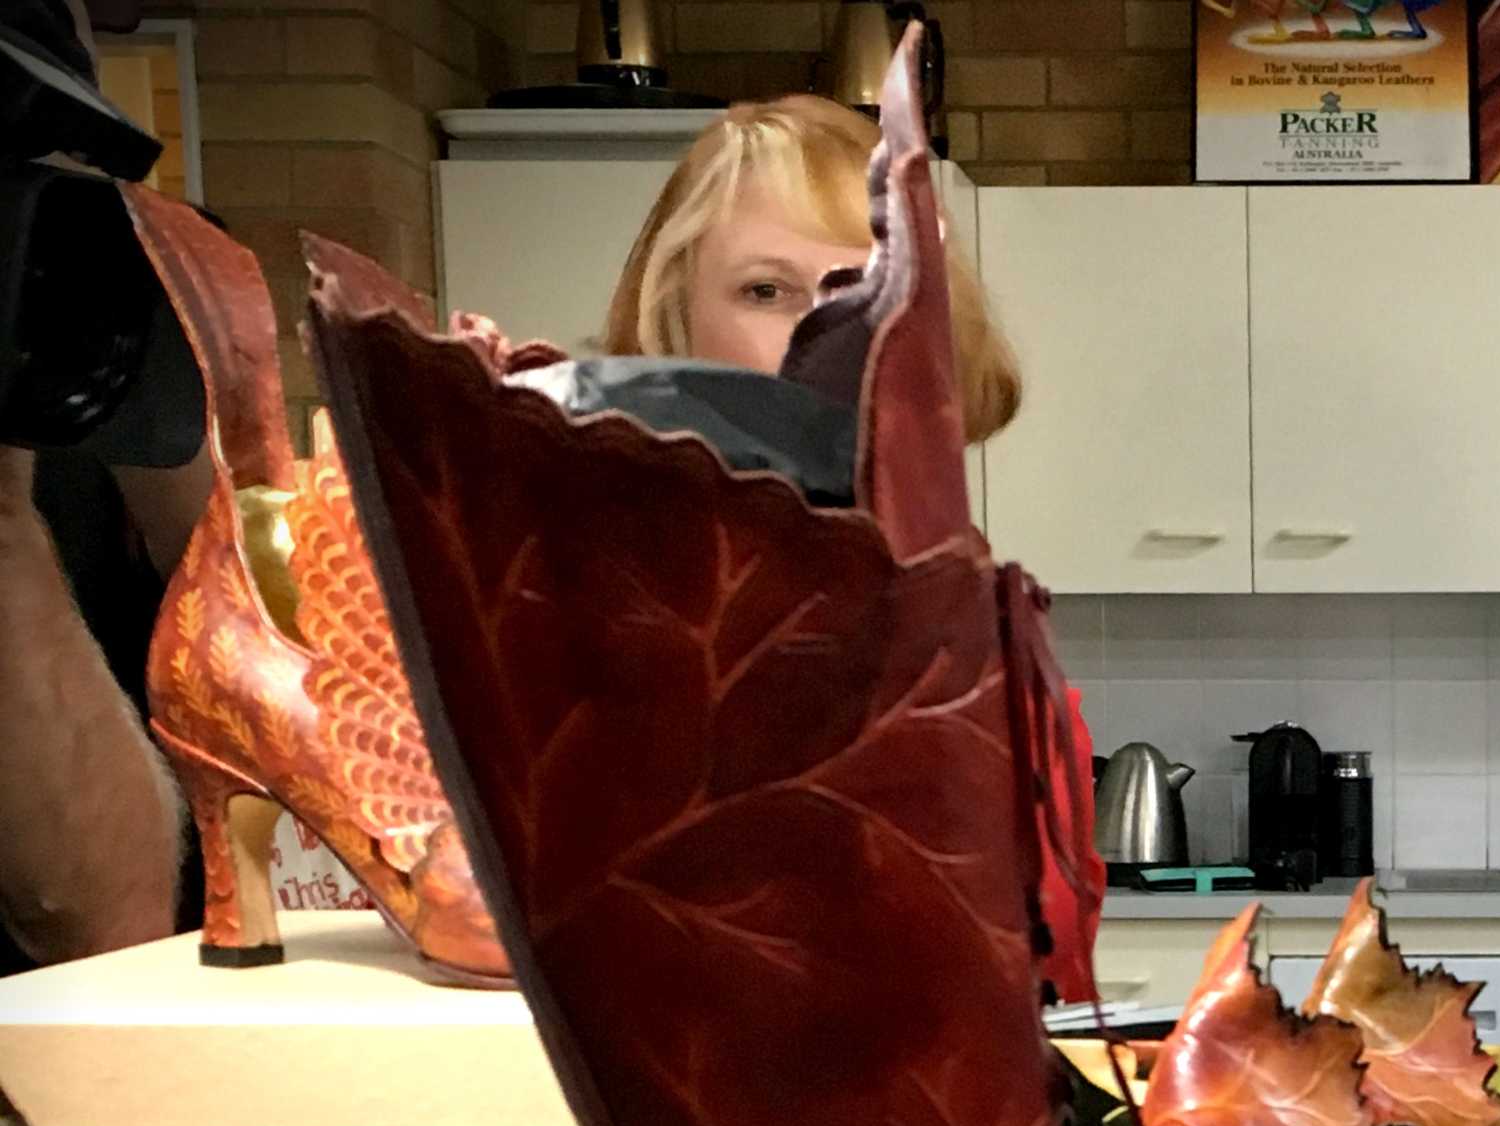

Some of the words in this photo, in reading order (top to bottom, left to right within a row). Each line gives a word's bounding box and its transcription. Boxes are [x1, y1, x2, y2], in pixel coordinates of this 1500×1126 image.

[1264, 62, 1287, 73] The
[1291, 62, 1339, 73] Natural
[1343, 62, 1403, 73] Selection
[1230, 75, 1244, 86] in
[1248, 75, 1292, 86] Bovine
[1297, 75, 1308, 86] &
[1311, 75, 1375, 88] Kangaroo
[1378, 74, 1435, 85] Leathers
[1279, 112, 1378, 133] PACKER
[1279, 137, 1380, 149] TANNING
[1293, 150, 1363, 159] AUSTRALIA
